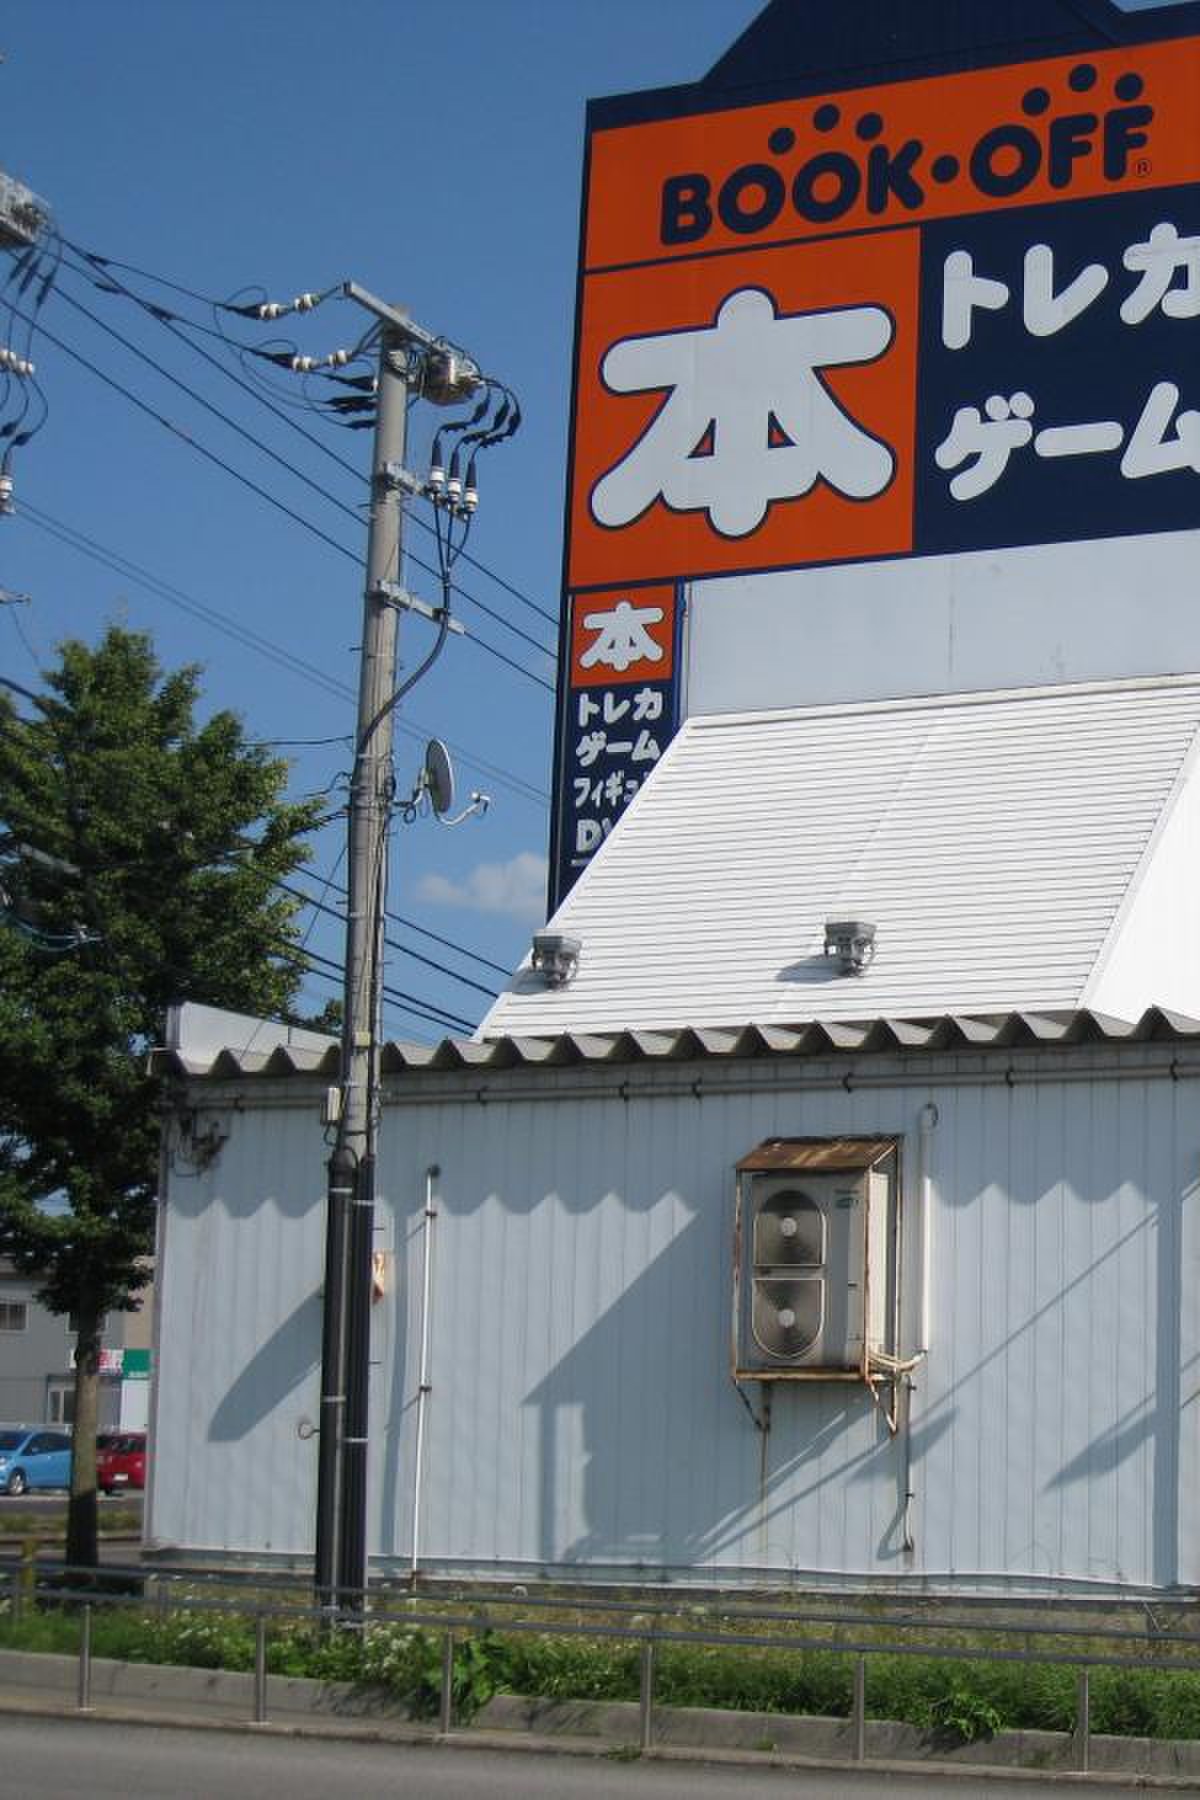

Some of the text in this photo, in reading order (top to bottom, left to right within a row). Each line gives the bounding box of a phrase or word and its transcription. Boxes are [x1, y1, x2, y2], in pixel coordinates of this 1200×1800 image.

[590, 285, 897, 541] 本
[578, 600, 665, 673] 本
[578, 687, 663, 728] トレカ
[575, 729, 662, 768] ゲーム
[573, 769, 649, 808] フィギュ
